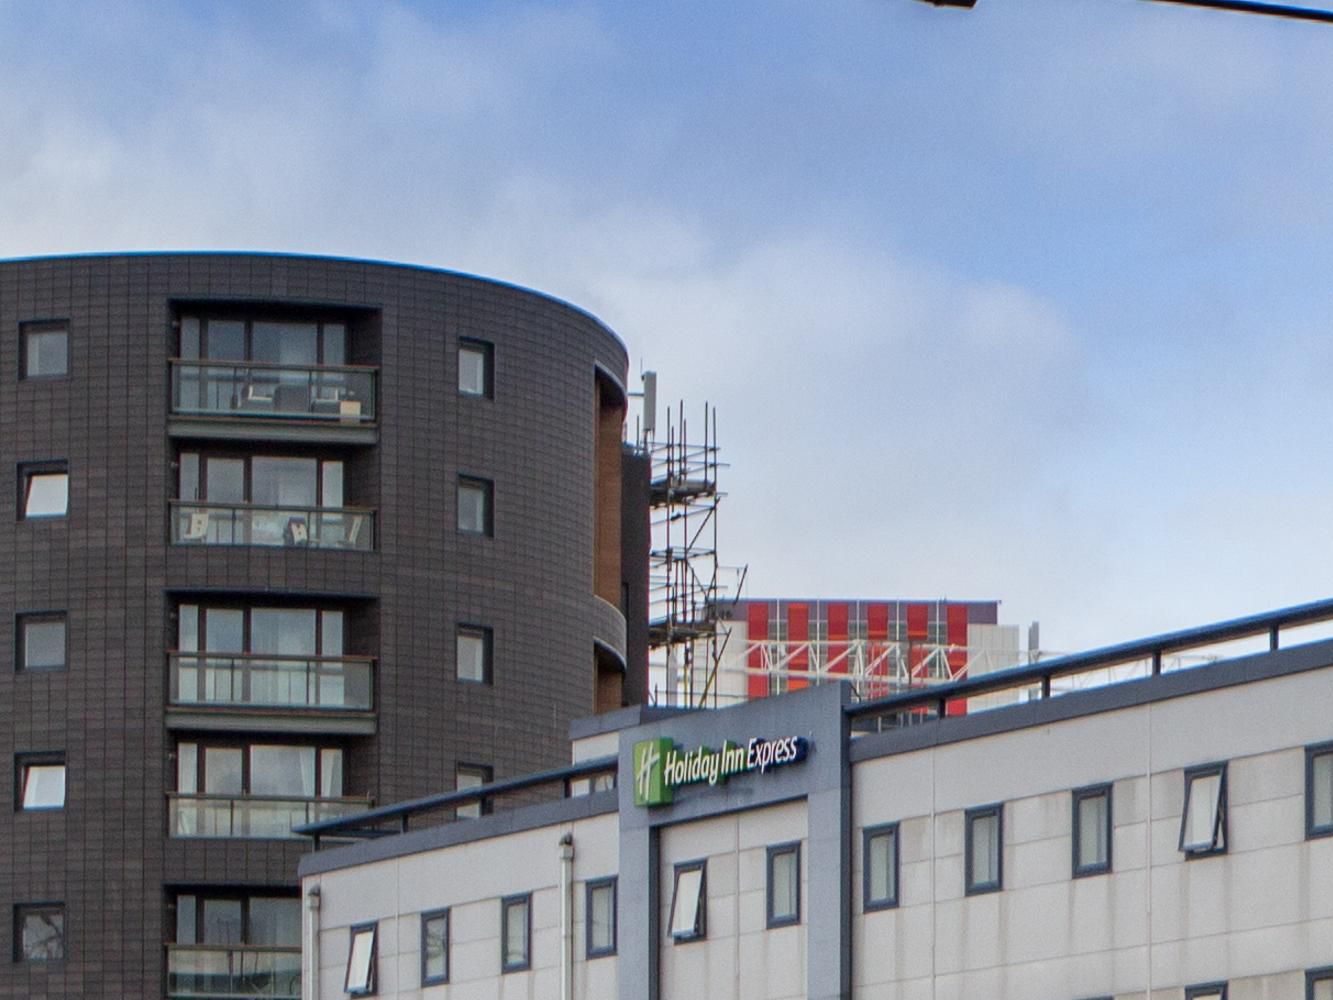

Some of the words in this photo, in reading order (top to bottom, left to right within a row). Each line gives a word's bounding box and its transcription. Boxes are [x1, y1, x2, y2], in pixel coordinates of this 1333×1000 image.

[664, 746, 720, 786] Holiday
[720, 739, 743, 774] Inn
[746, 735, 798, 775] Express
